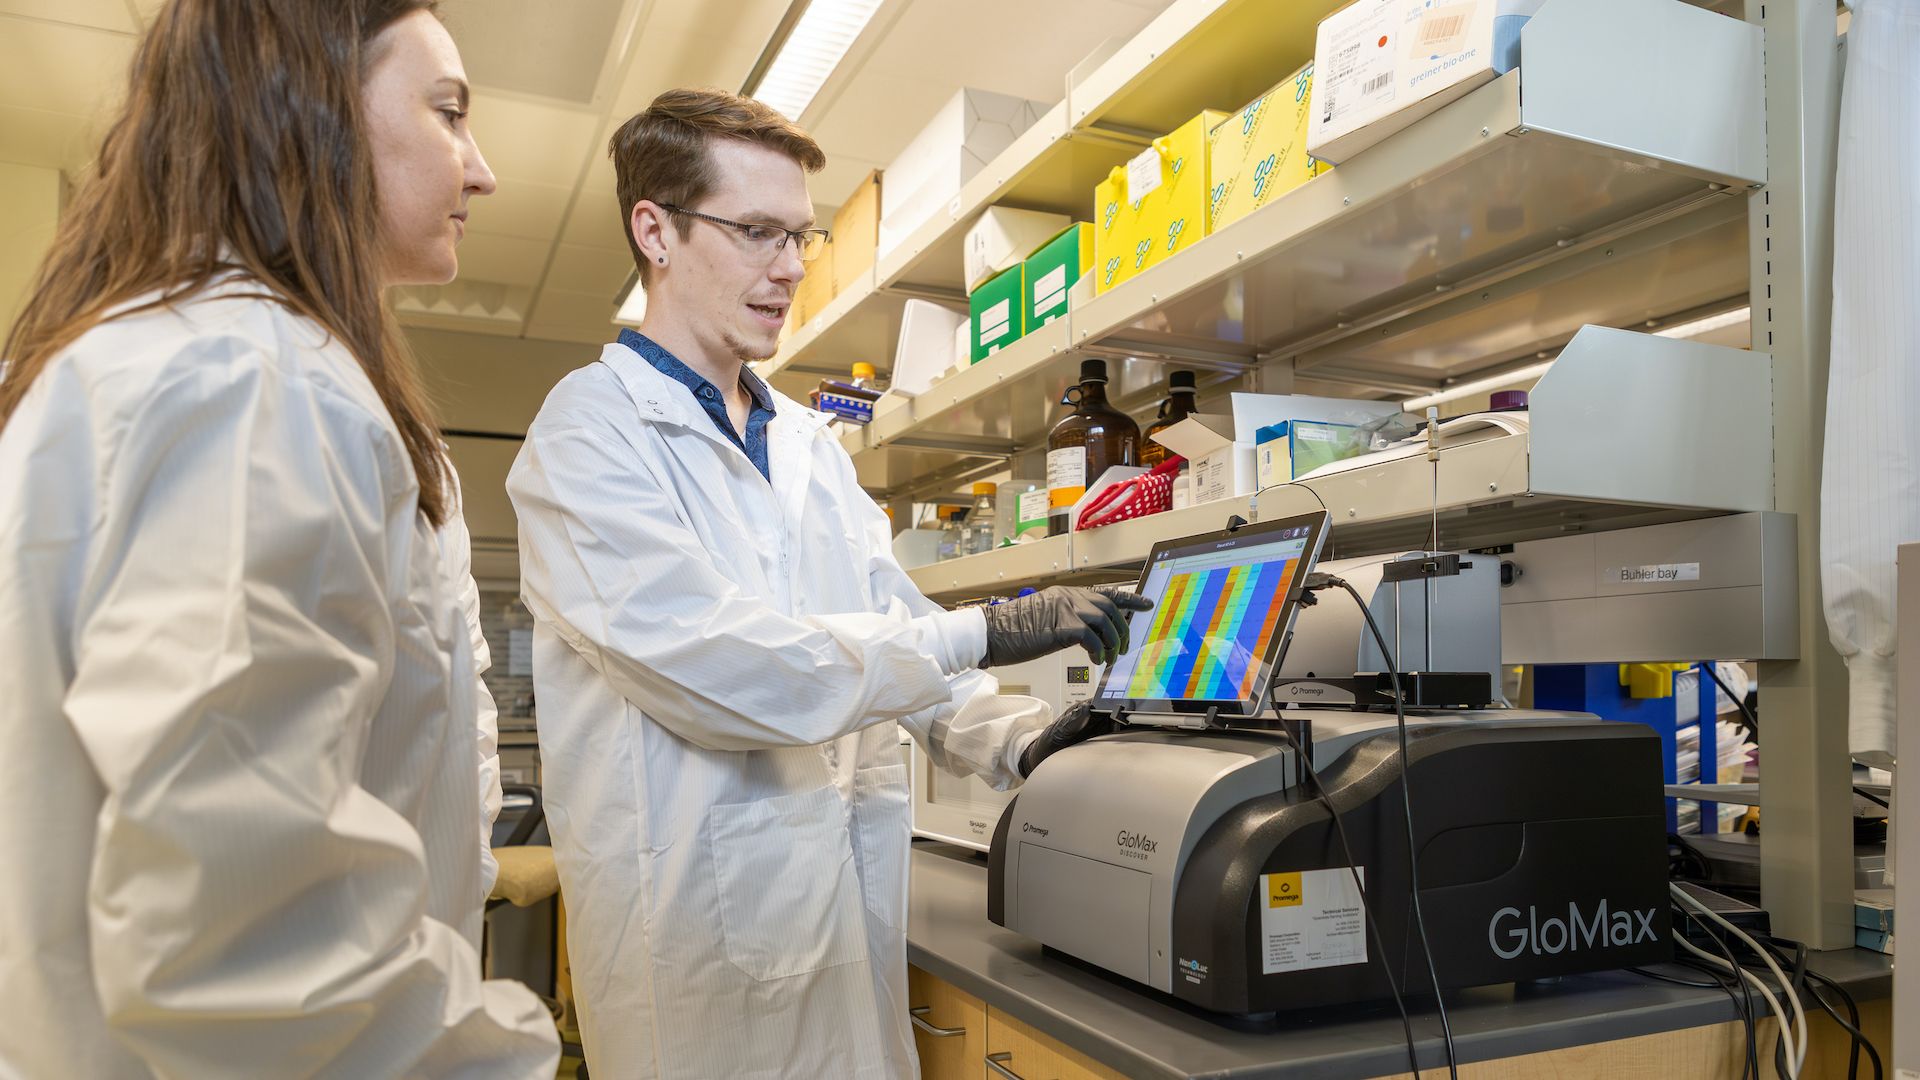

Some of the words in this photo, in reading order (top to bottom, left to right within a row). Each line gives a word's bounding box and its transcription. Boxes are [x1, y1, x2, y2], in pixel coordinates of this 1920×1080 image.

[1410, 64, 1442, 87] greiner
[1444, 57, 1458, 70] bio
[1458, 48, 1476, 62] one
[1621, 568, 1656, 580] Buhler
[1658, 568, 1678, 580] bay
[1299, 688, 1324, 696] Promega
[1029, 824, 1048, 838] Promega
[1118, 830, 1158, 853] GloMax
[1120, 849, 1148, 860] DISCOVER
[1488, 898, 1658, 960] GloMax
